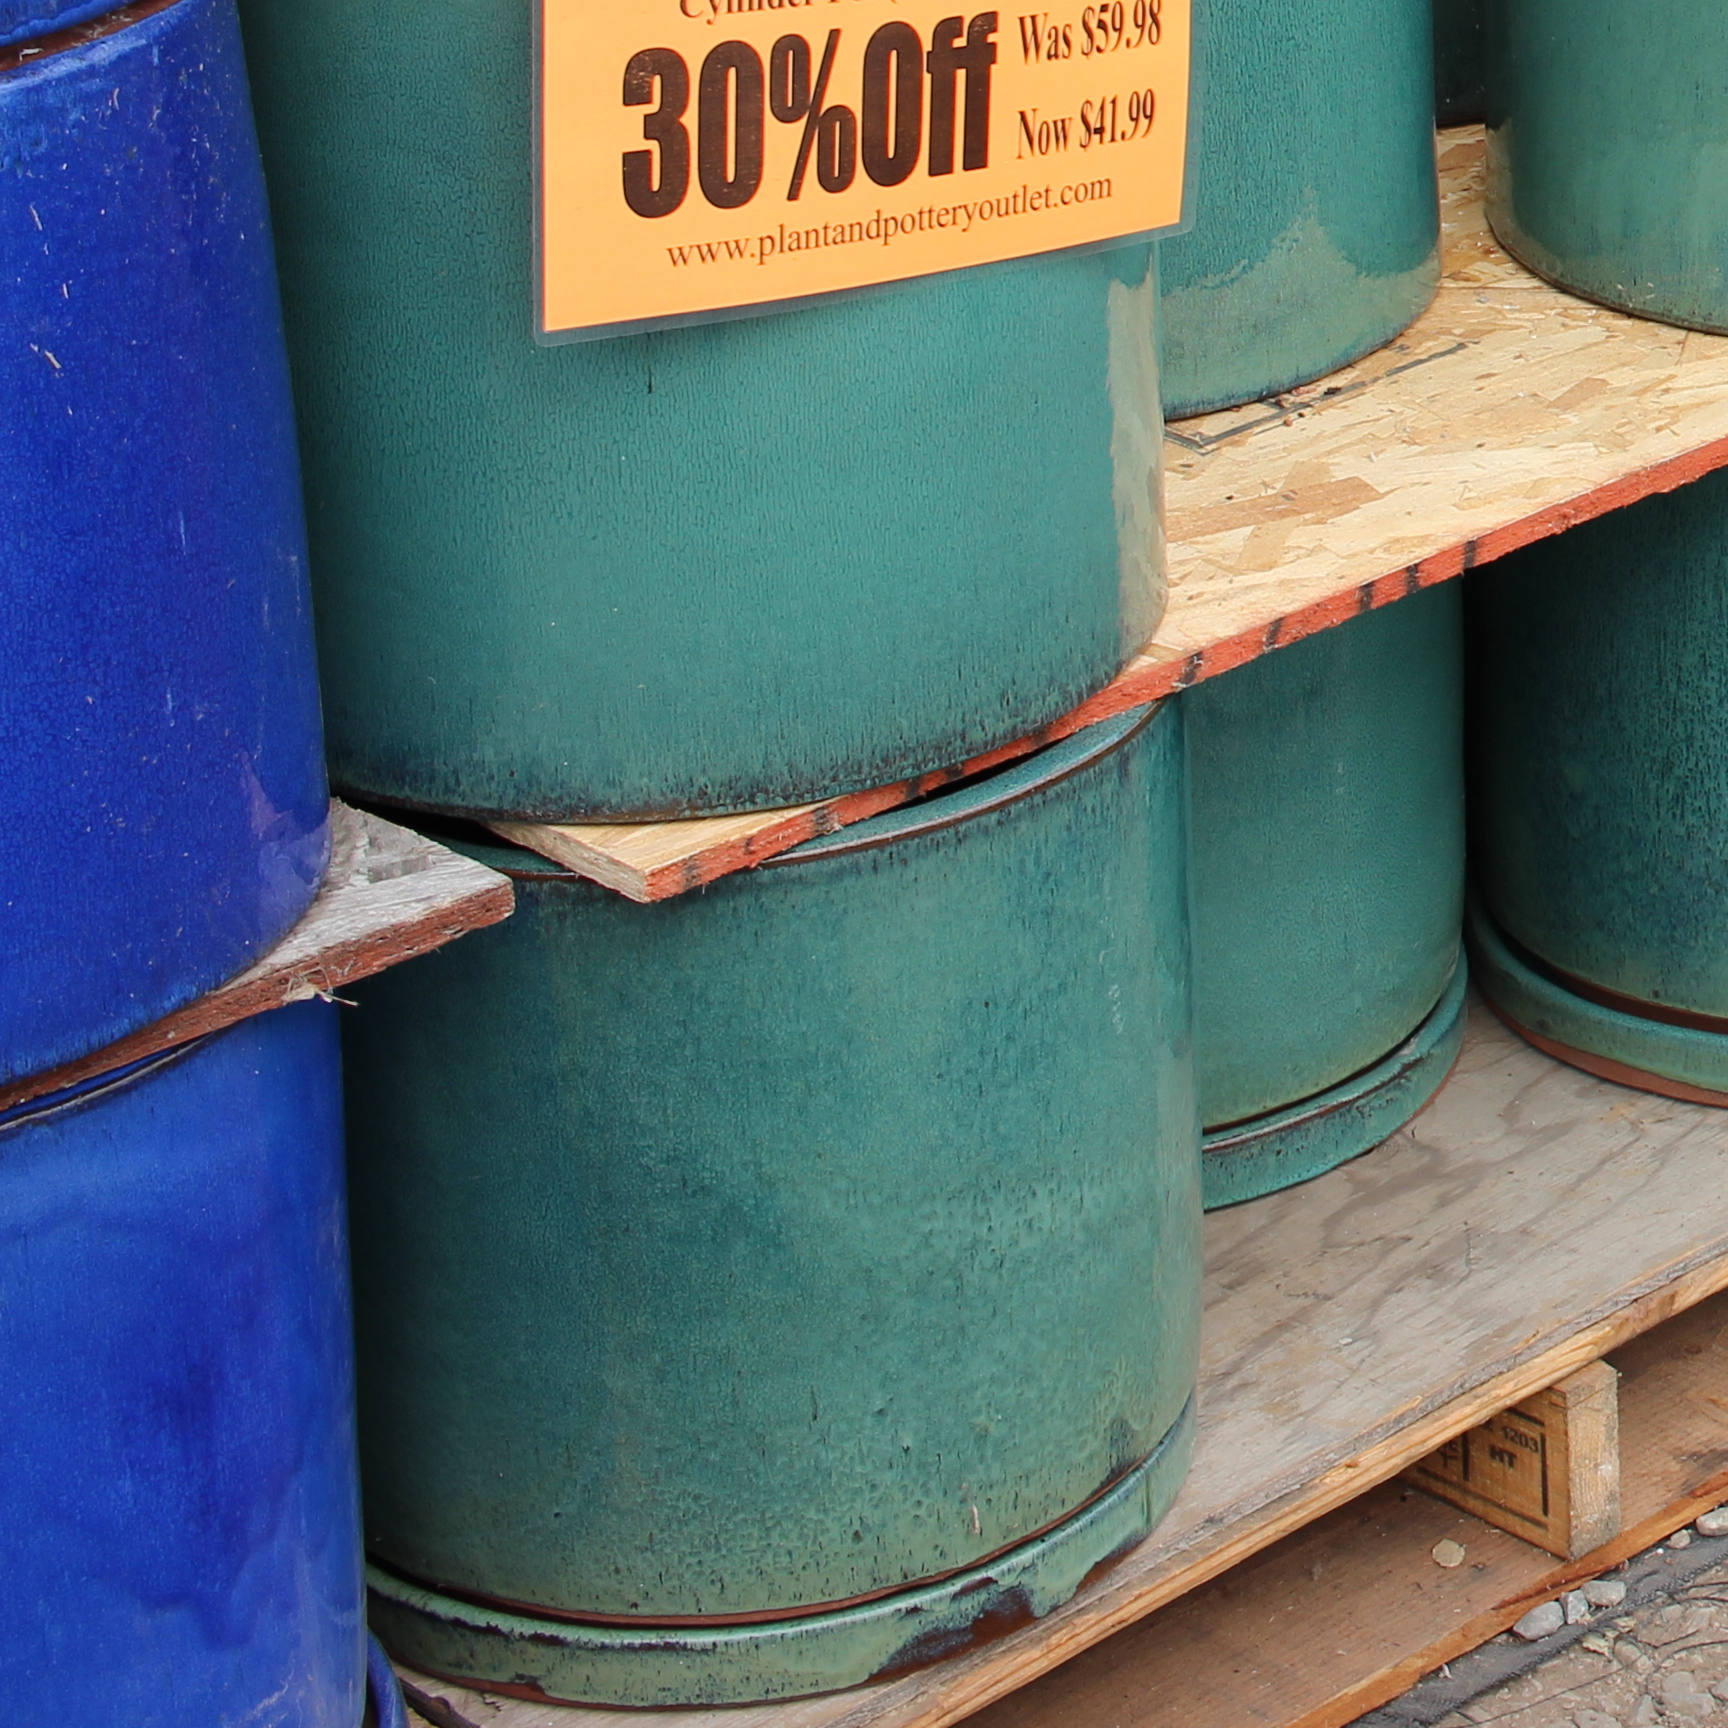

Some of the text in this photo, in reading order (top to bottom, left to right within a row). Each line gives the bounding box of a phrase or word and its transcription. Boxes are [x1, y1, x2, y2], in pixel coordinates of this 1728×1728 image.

[1016, 12, 1073, 65] Was
[621, 10, 998, 220] 30%Off
[1015, 88, 1156, 160] Now $41.99
[666, 174, 1113, 268] www.plantandpotteryoutlet.com
[1489, 1444, 1518, 1469] HT
